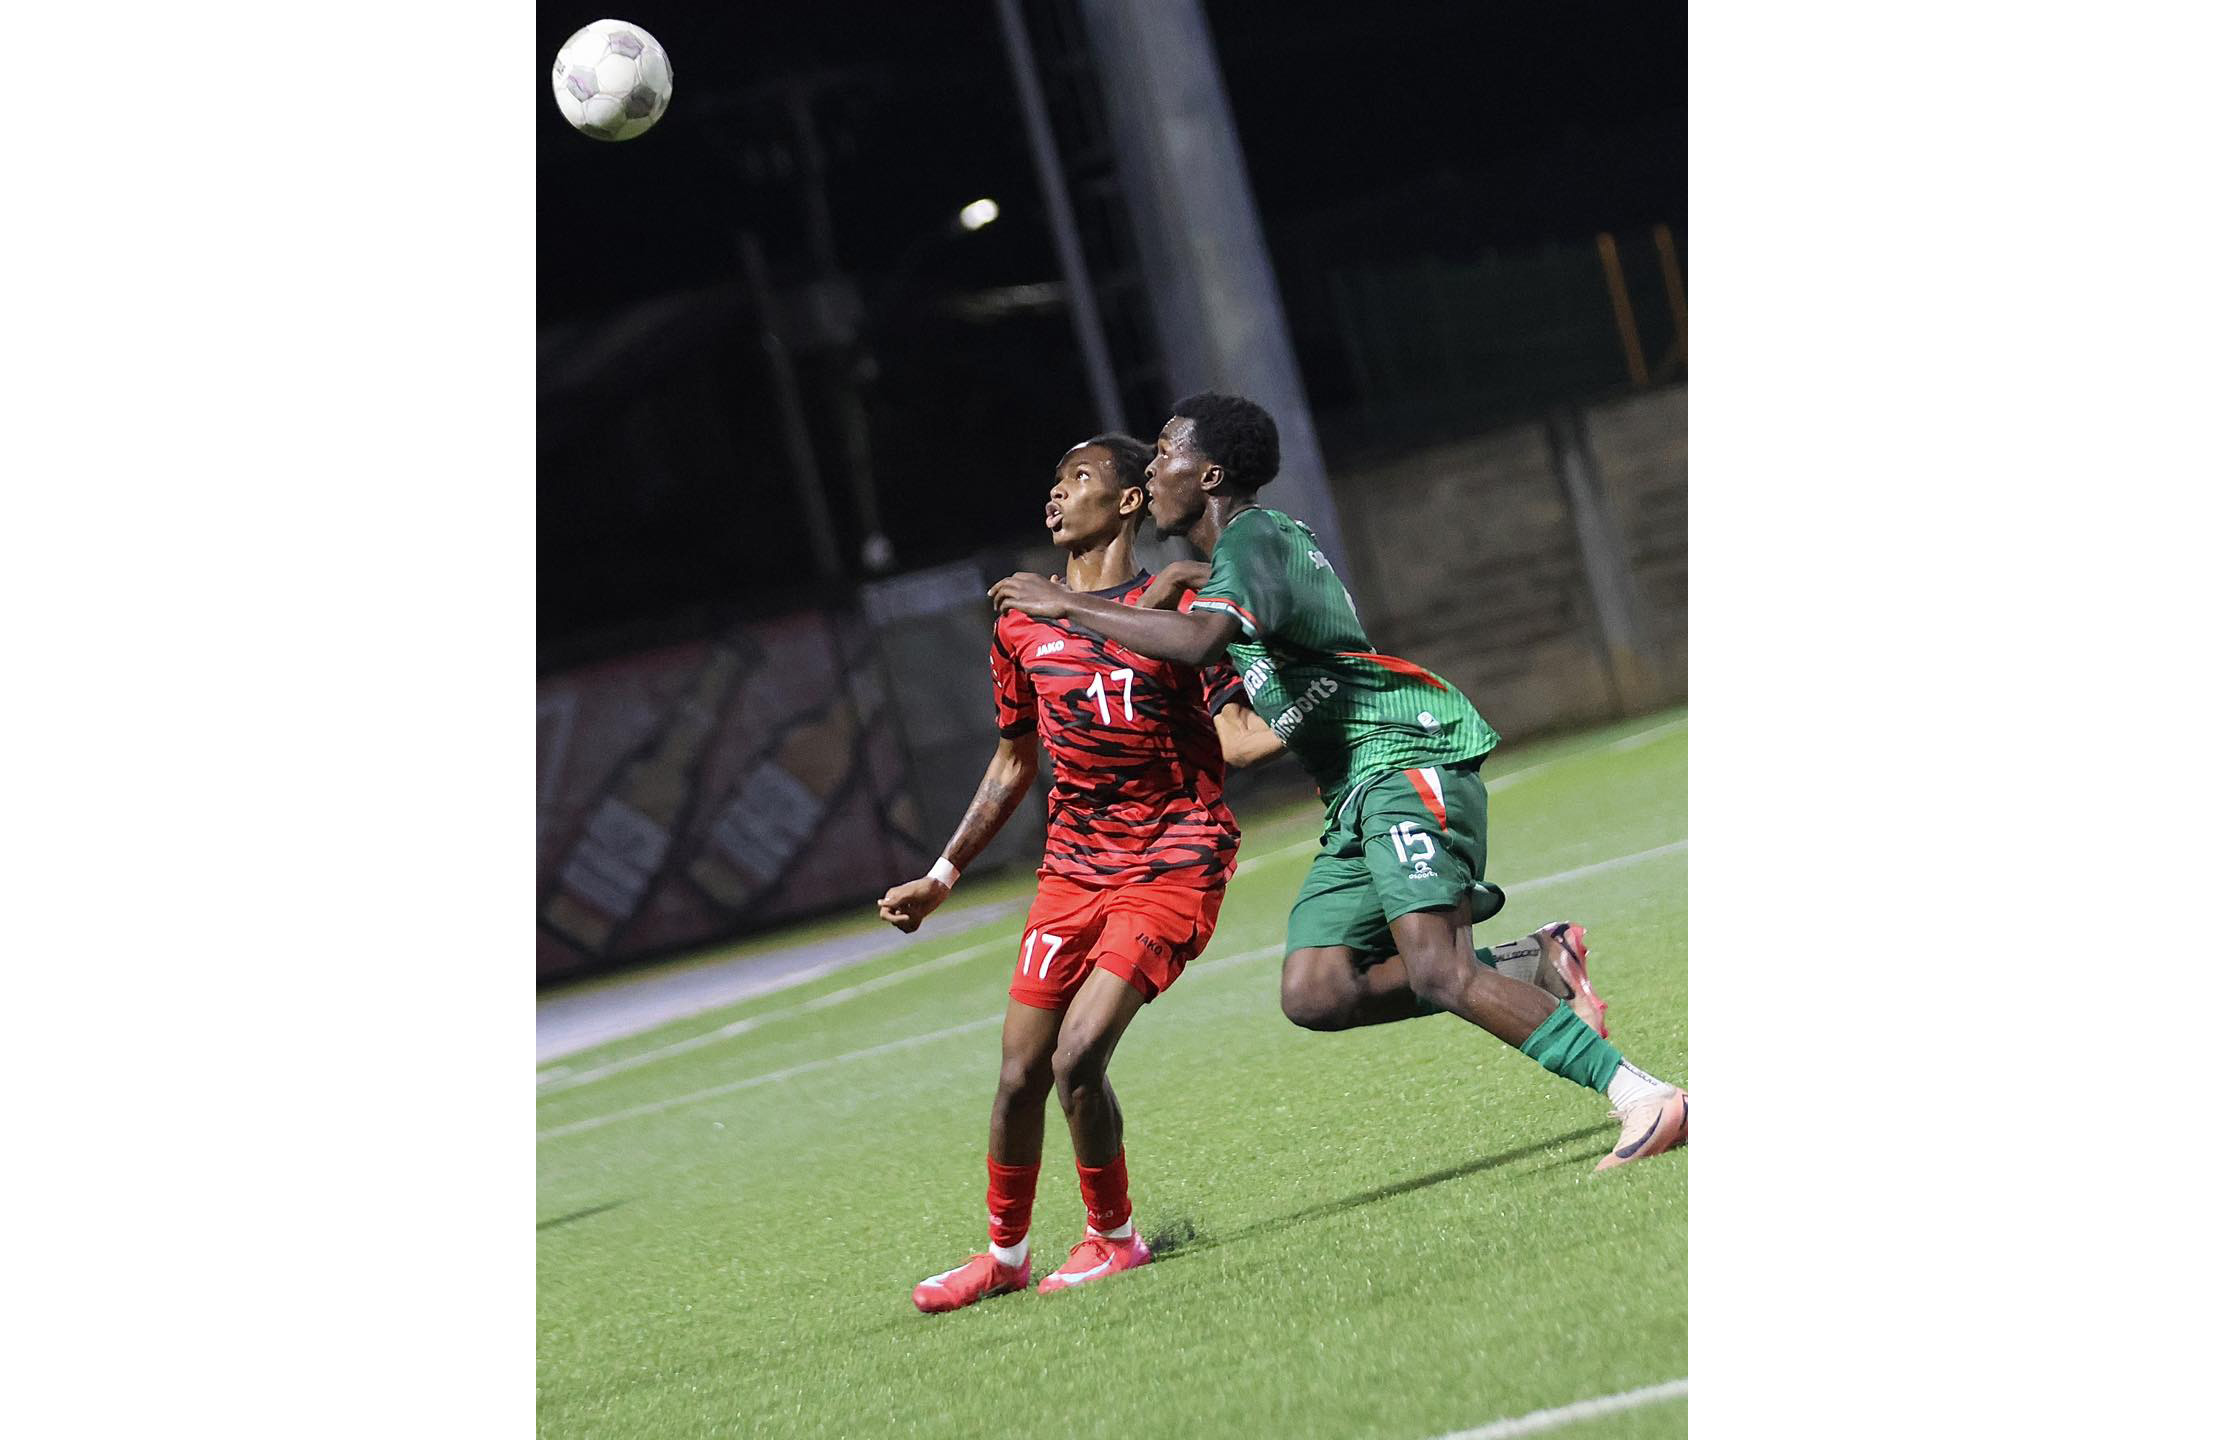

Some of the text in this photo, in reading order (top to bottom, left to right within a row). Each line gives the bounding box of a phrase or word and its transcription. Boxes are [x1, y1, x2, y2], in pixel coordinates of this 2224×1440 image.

[1036, 640, 1064, 656] JAKO
[1087, 668, 1135, 727] 17
[1390, 821, 1435, 862] 15
[1023, 928, 1062, 980] 17
[1135, 932, 1163, 955] JAKO
